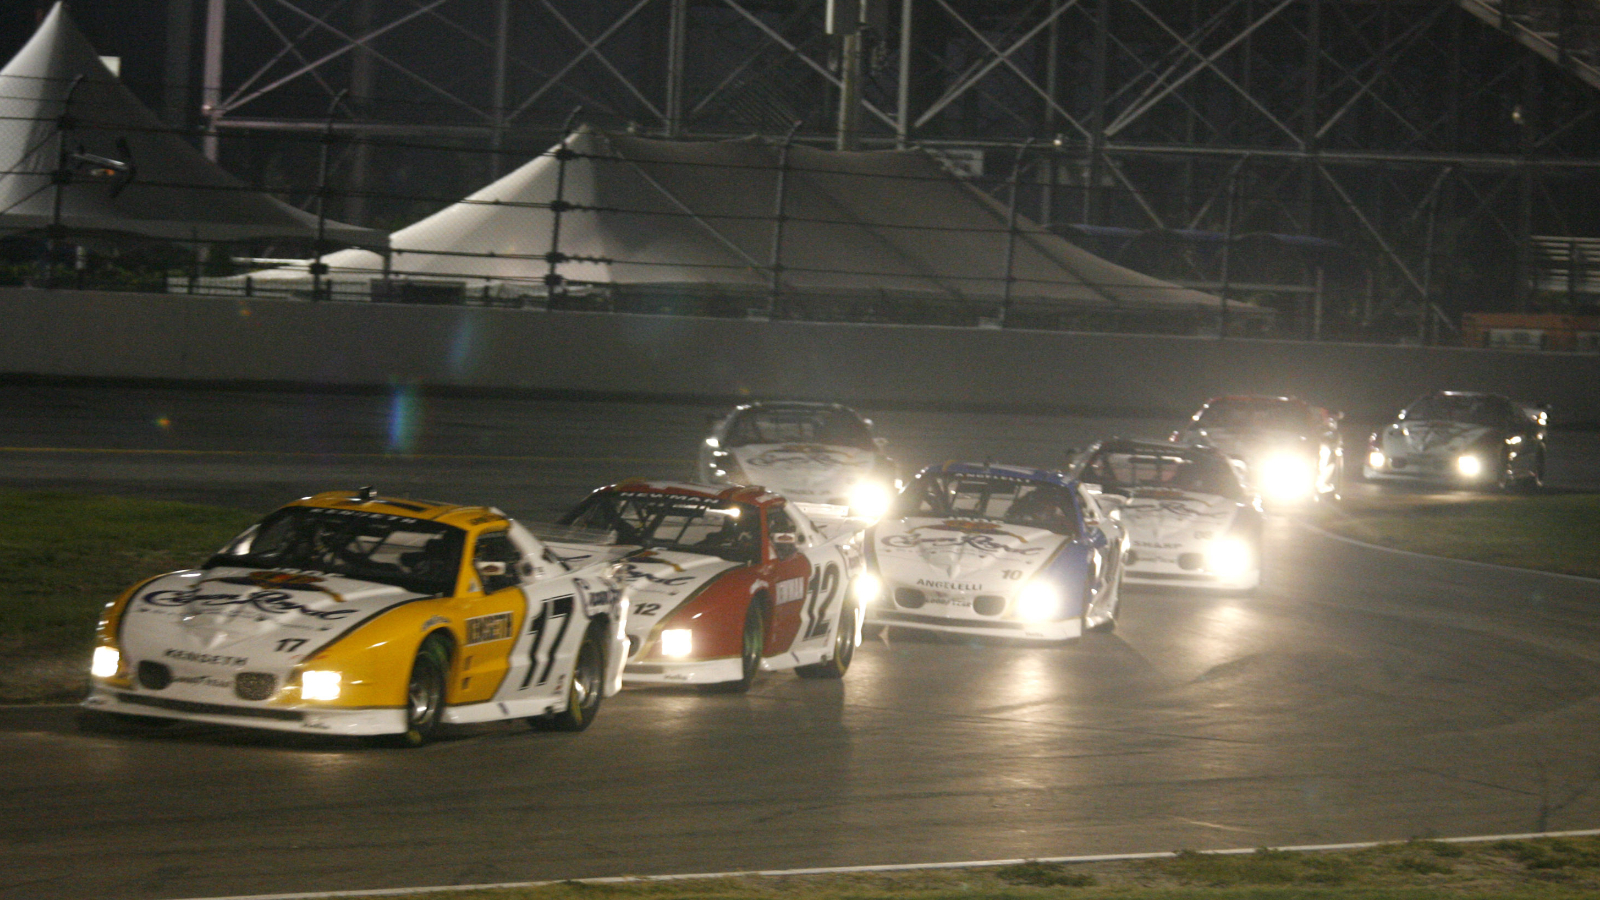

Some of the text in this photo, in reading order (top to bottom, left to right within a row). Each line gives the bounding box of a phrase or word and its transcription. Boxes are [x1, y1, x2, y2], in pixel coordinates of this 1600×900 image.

[620, 491, 720, 504] NEWMAN
[1001, 569, 1023, 580] 10
[916, 578, 982, 591] ANGELELLI
[633, 602, 662, 616] 12
[807, 562, 840, 642] 12
[275, 638, 310, 652] 17
[518, 593, 575, 691] 17
